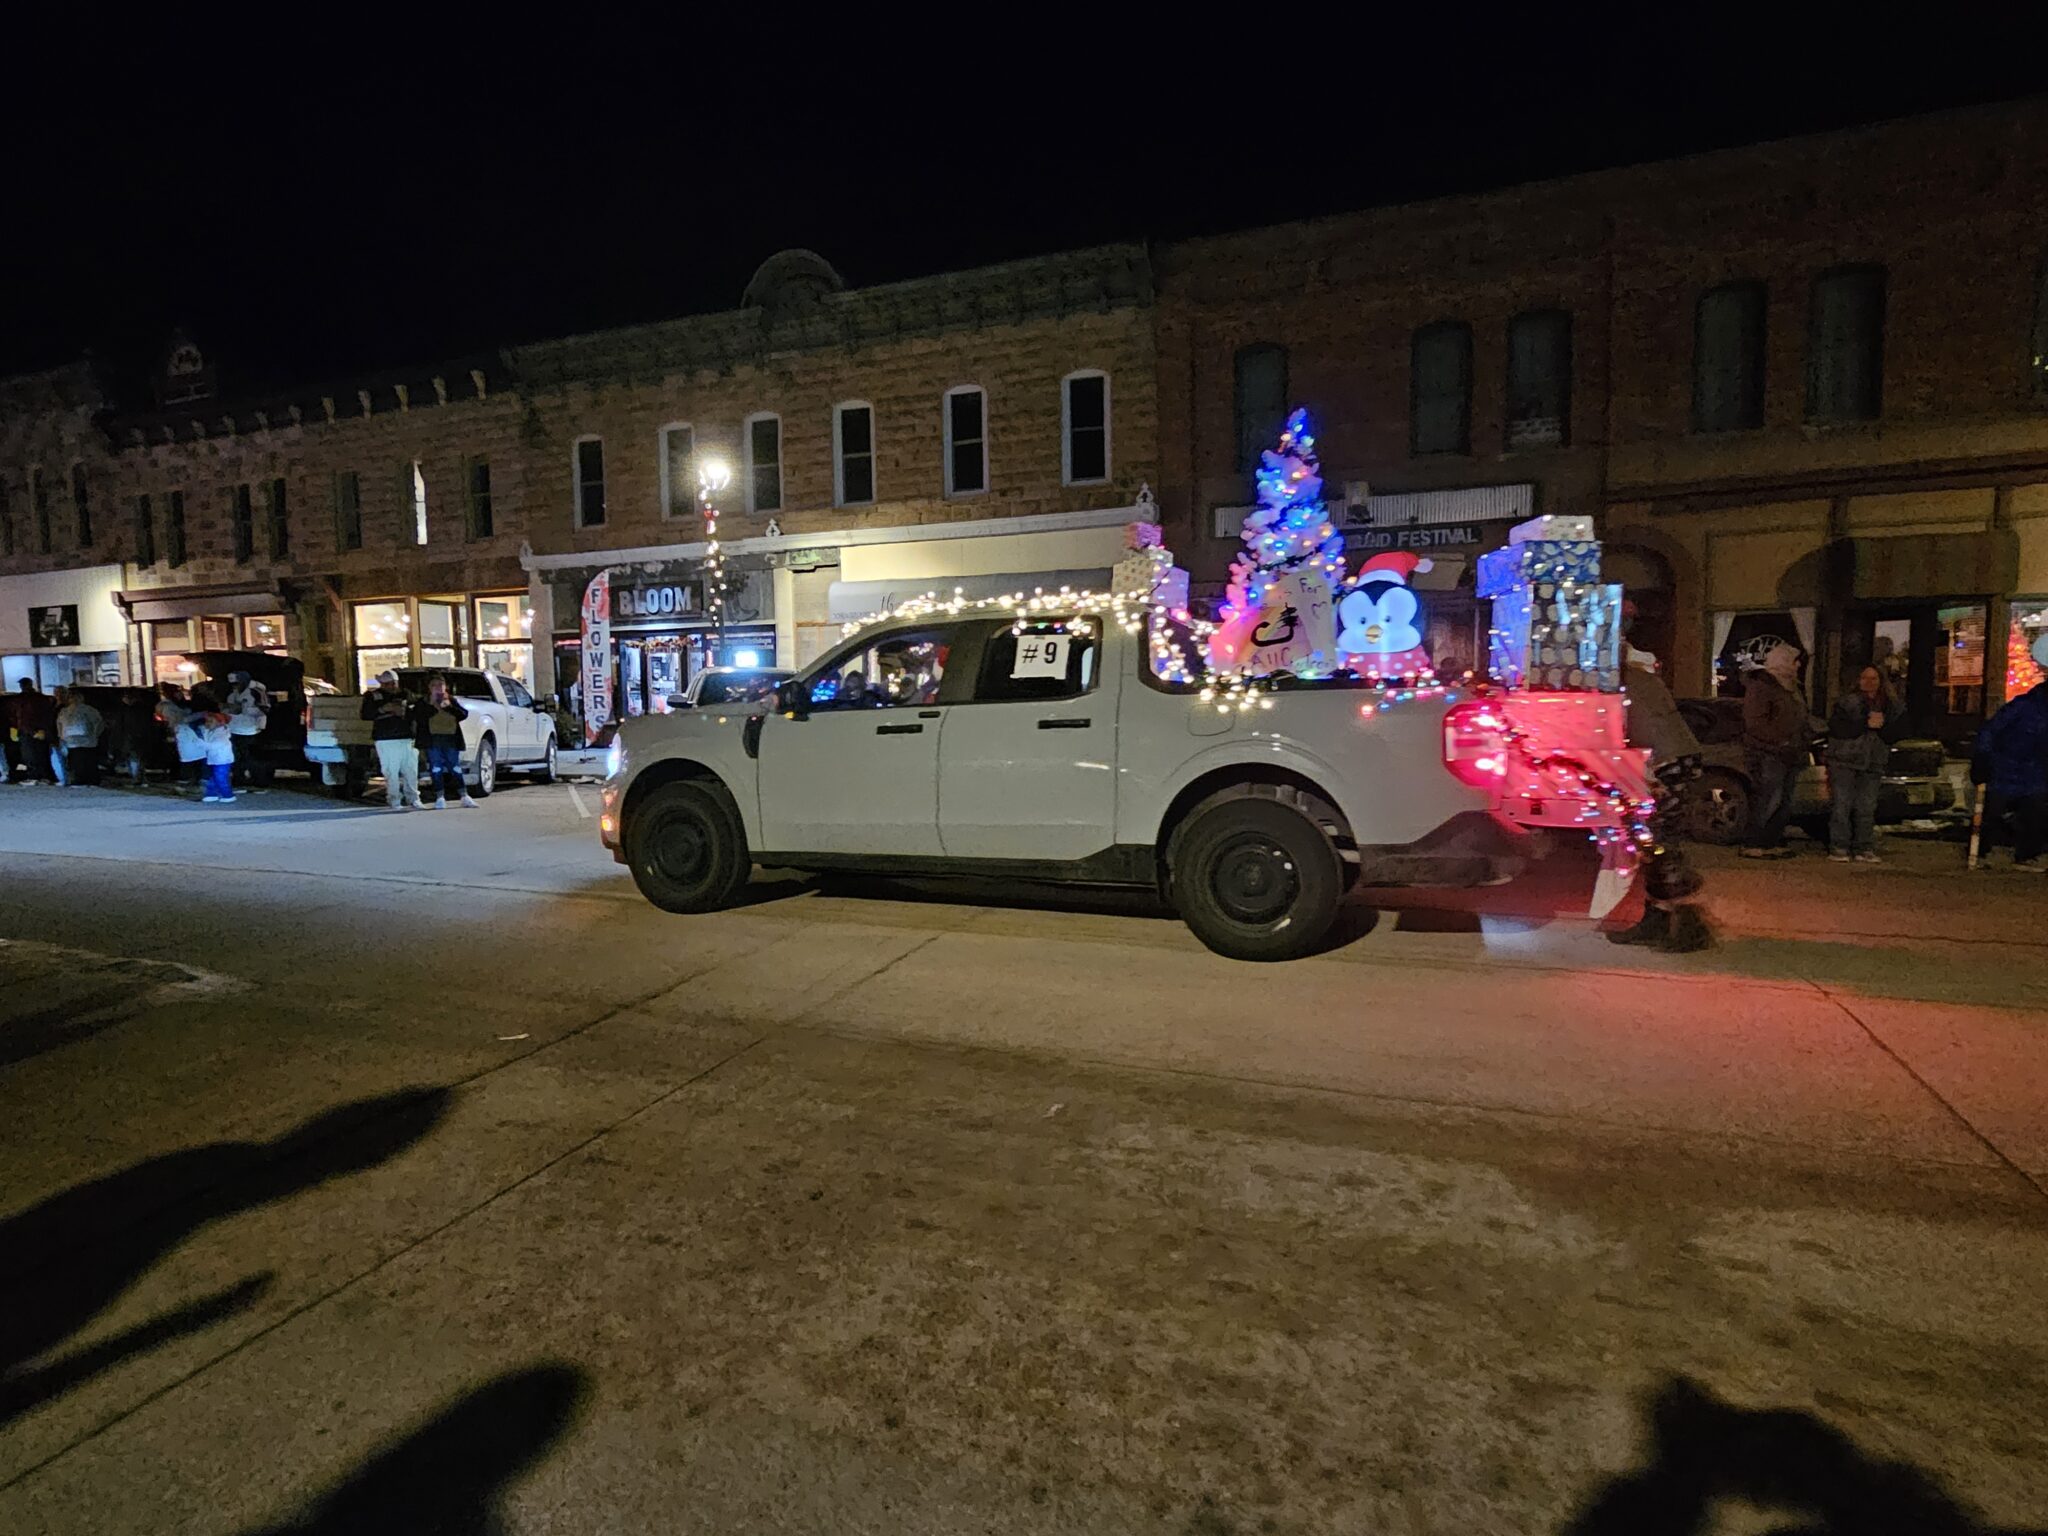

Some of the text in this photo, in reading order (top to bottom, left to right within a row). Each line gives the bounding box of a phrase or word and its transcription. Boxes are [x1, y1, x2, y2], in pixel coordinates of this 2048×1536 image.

[1397, 527, 1478, 548] FESTIVAL
[618, 586, 693, 616] BLOOM
[588, 588, 605, 730] FLOWERS
